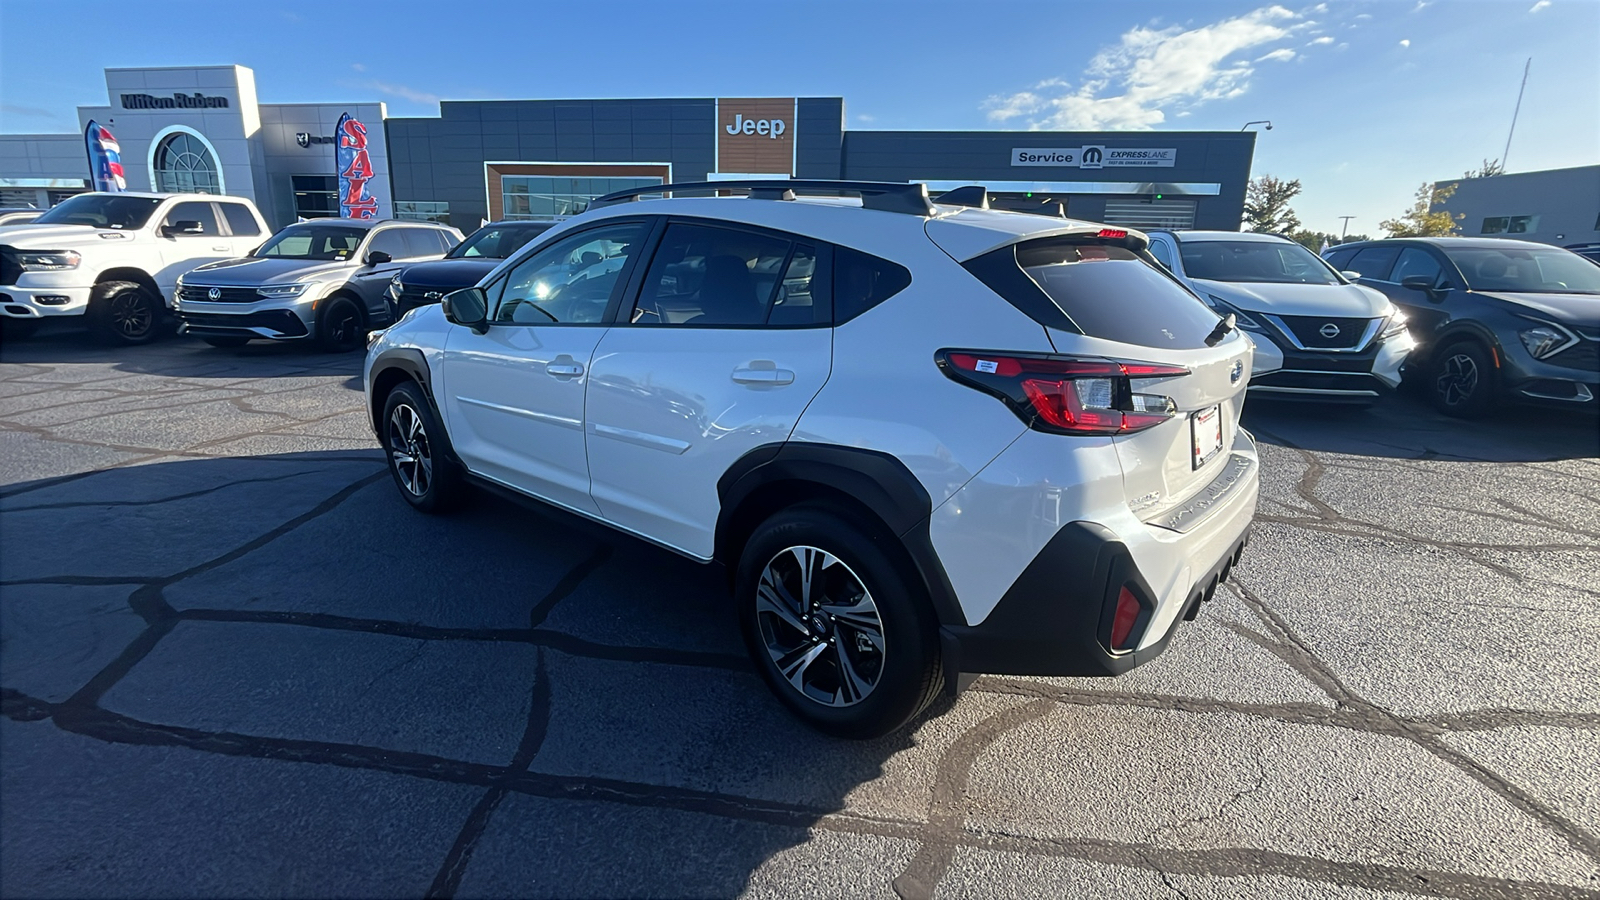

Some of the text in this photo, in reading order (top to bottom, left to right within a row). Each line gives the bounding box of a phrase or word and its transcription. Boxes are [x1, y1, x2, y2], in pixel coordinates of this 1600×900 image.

[121, 93, 229, 109] Milton Ruben
[726, 114, 785, 139] Jeep
[1019, 152, 1073, 162] Service
